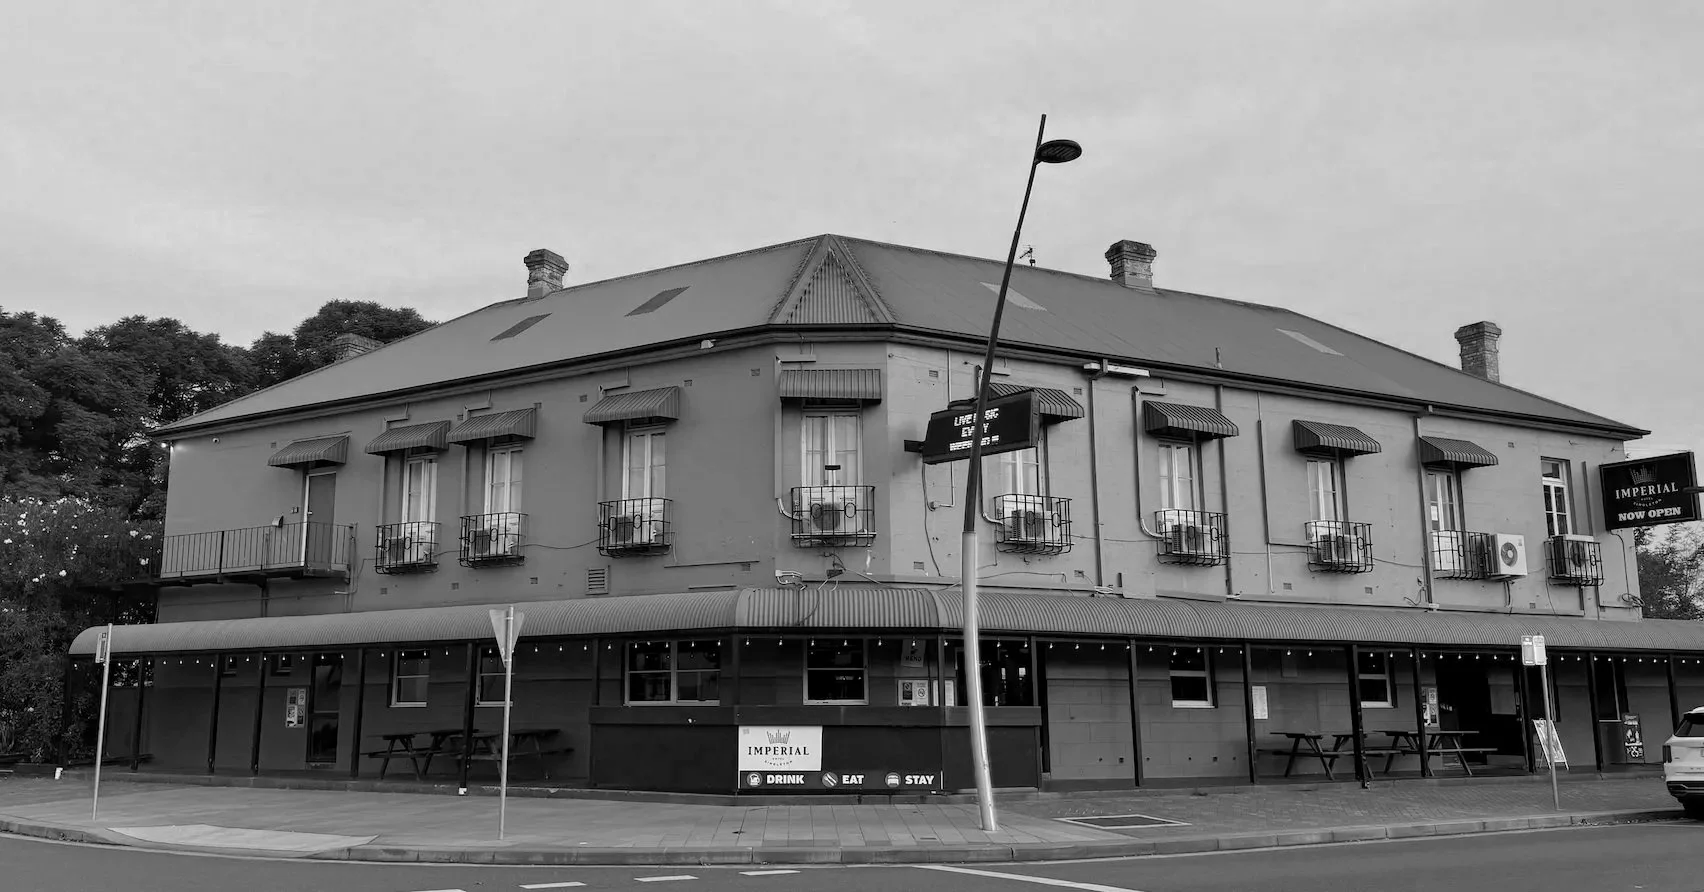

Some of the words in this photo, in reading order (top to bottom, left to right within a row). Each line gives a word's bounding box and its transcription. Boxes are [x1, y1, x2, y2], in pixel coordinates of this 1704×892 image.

[953, 414, 973, 426] LIVE
[961, 423, 989, 437] EVY
[1615, 482, 1679, 499] IMPERIAL
[1618, 510, 1646, 521] NOW
[1647, 506, 1682, 518] OPEN
[748, 746, 810, 756] IMPERIAL
[766, 774, 805, 785] DRINK
[842, 774, 865, 785] EAT
[905, 775, 935, 785] STAY
